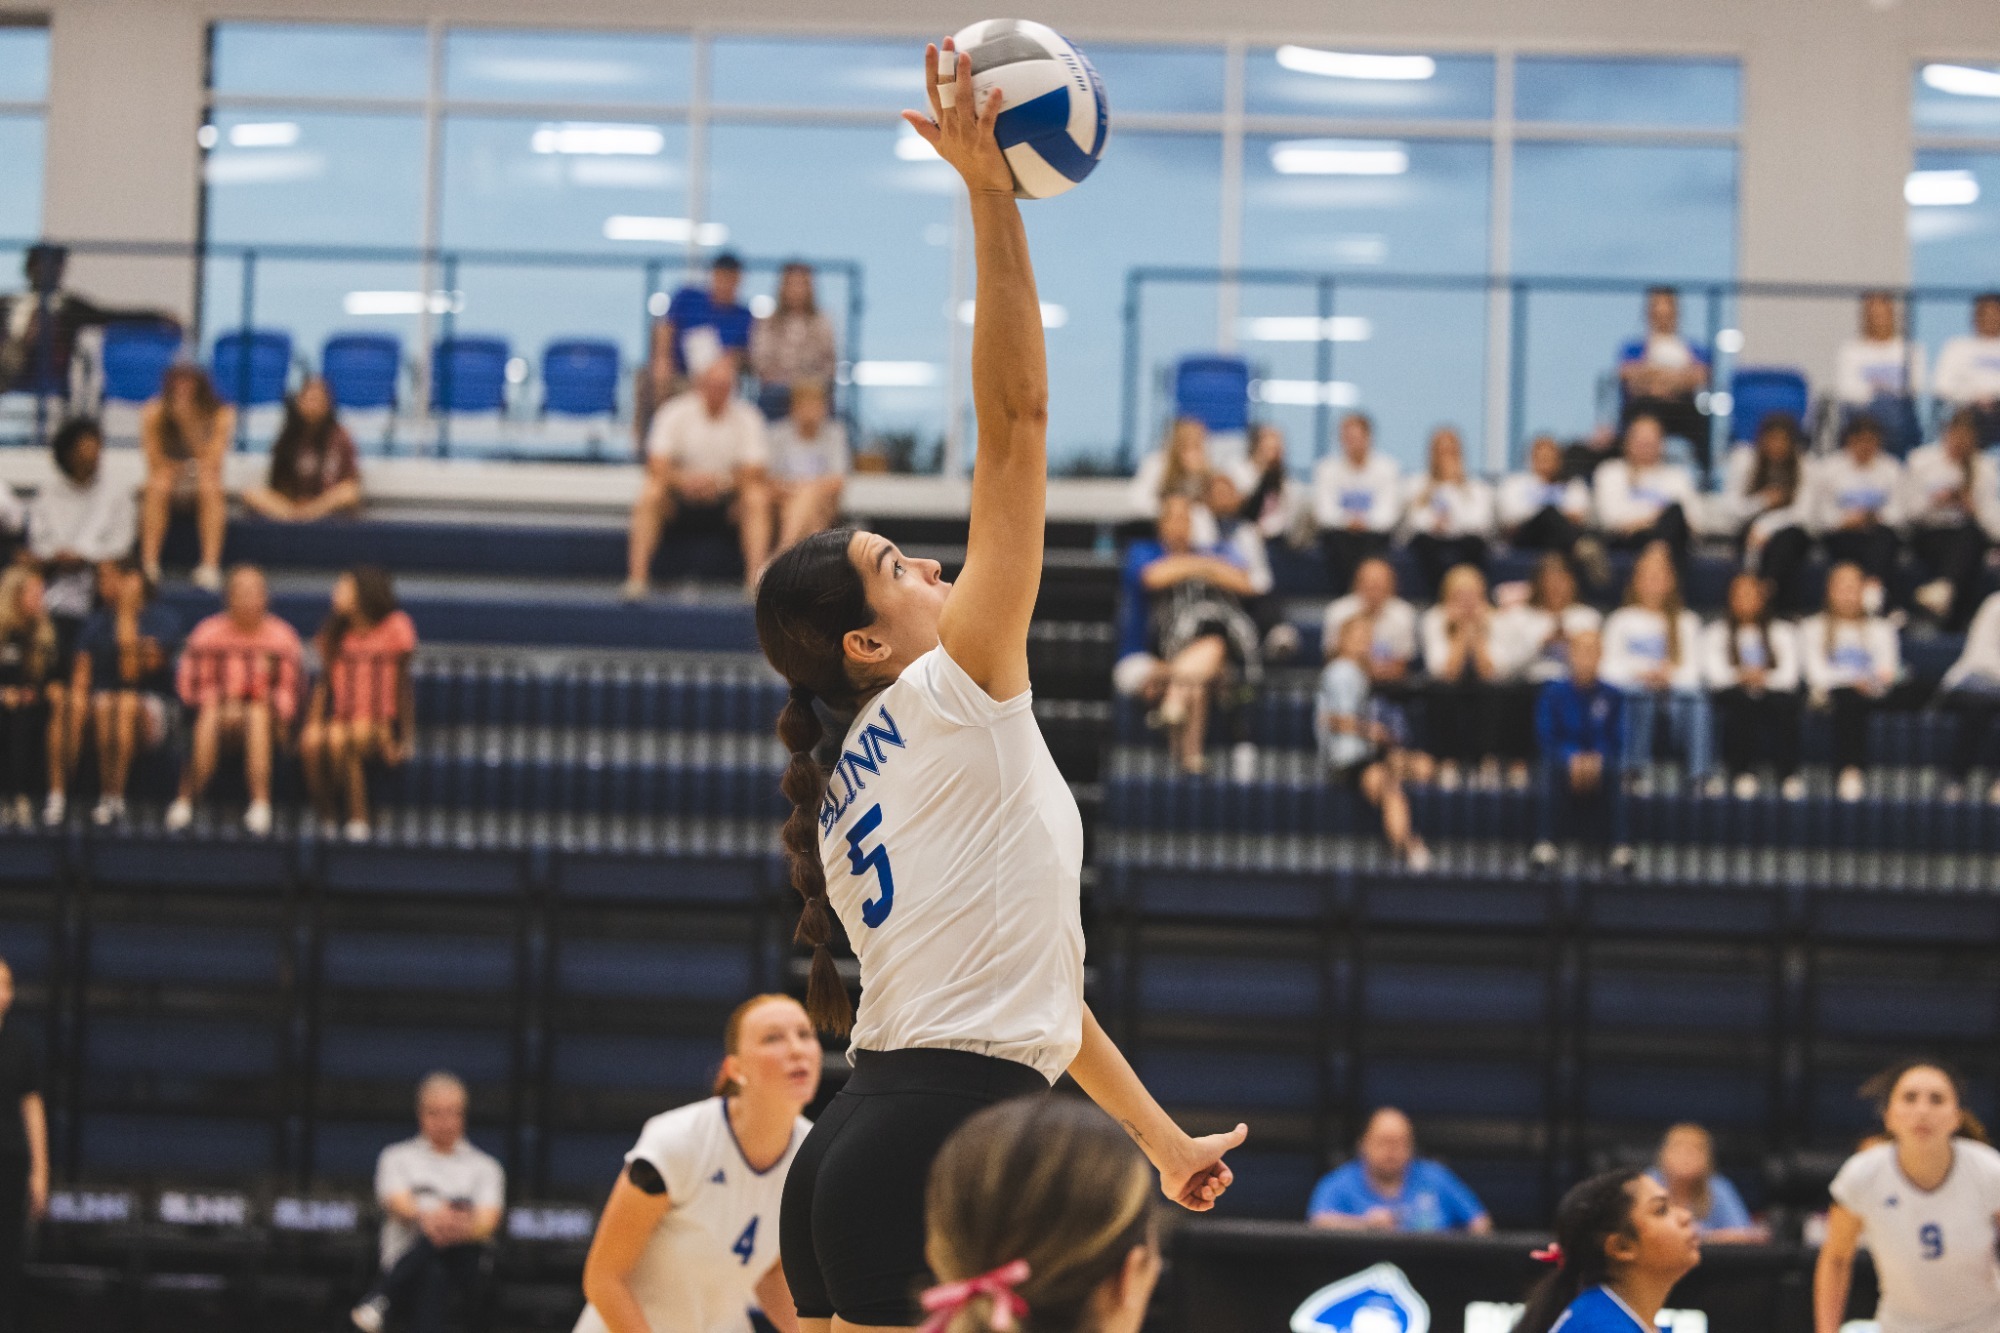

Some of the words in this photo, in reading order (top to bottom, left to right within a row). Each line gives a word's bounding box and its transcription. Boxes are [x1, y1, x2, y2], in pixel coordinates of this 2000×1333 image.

[845, 802, 895, 929] 5
[732, 1215, 759, 1265] 4
[1920, 1223, 1944, 1260] 9
